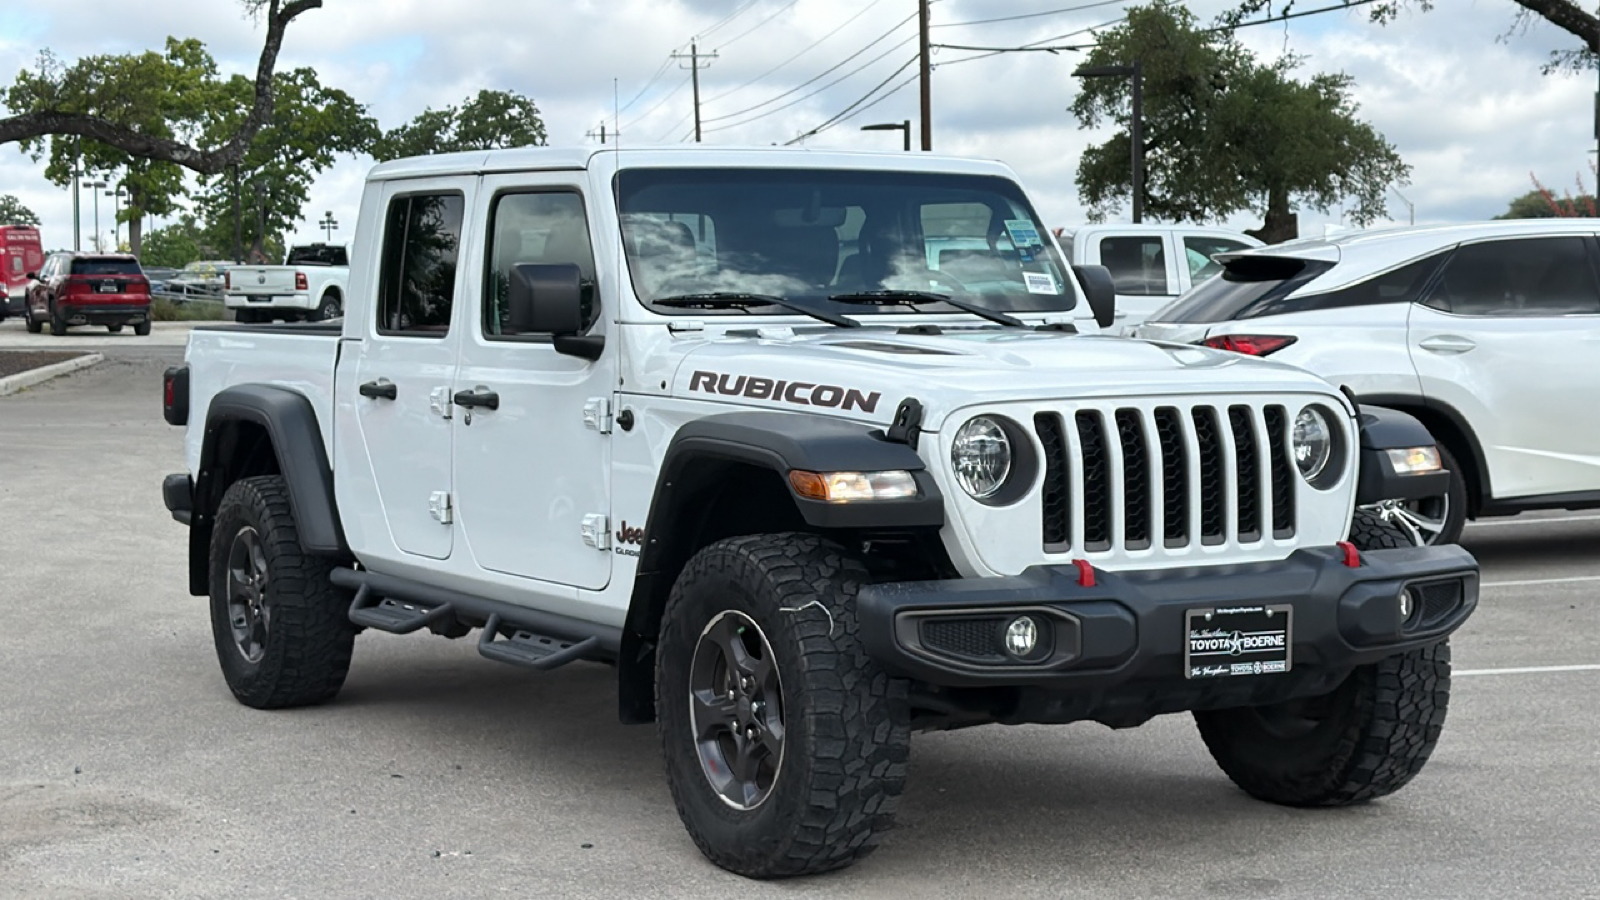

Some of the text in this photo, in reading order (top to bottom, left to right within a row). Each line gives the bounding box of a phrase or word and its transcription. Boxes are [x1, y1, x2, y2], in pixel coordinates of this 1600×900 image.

[688, 370, 882, 414] RUBICON
[615, 519, 645, 546] Jee
[1190, 634, 1285, 651] TOYOTA BOERNE
